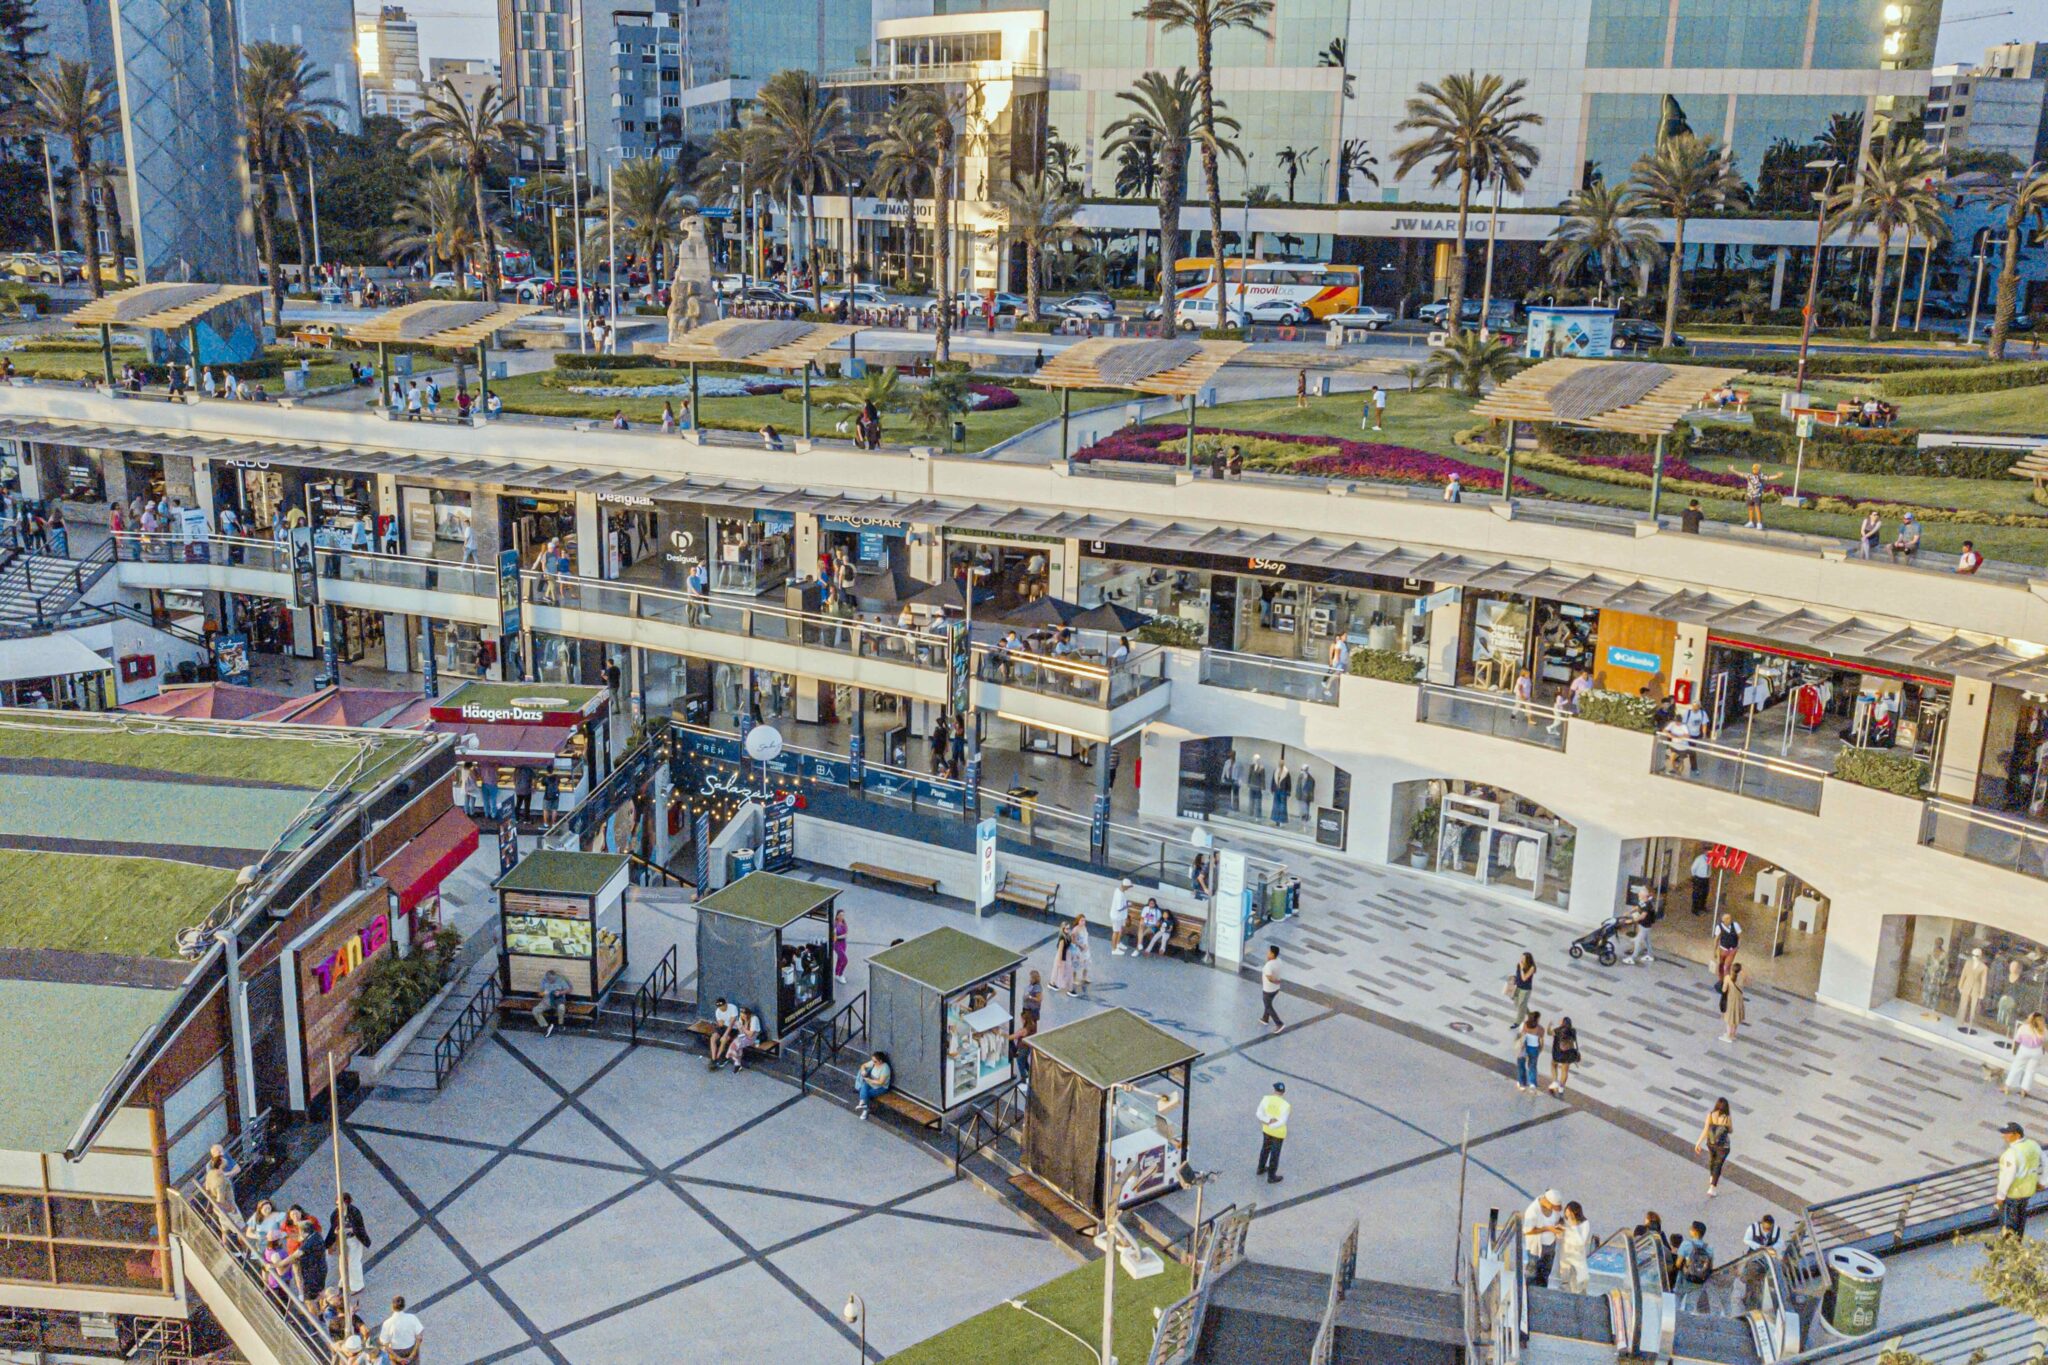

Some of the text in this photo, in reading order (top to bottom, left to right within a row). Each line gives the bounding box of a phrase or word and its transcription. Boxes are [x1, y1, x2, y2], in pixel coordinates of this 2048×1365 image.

[873, 204, 935, 217] JW MARIOT
[1391, 218, 1507, 233] JW MARIOT
[225, 458, 270, 469] ALDO
[825, 513, 902, 528] LARCOMAR
[462, 705, 544, 722] Häagen-Dazs
